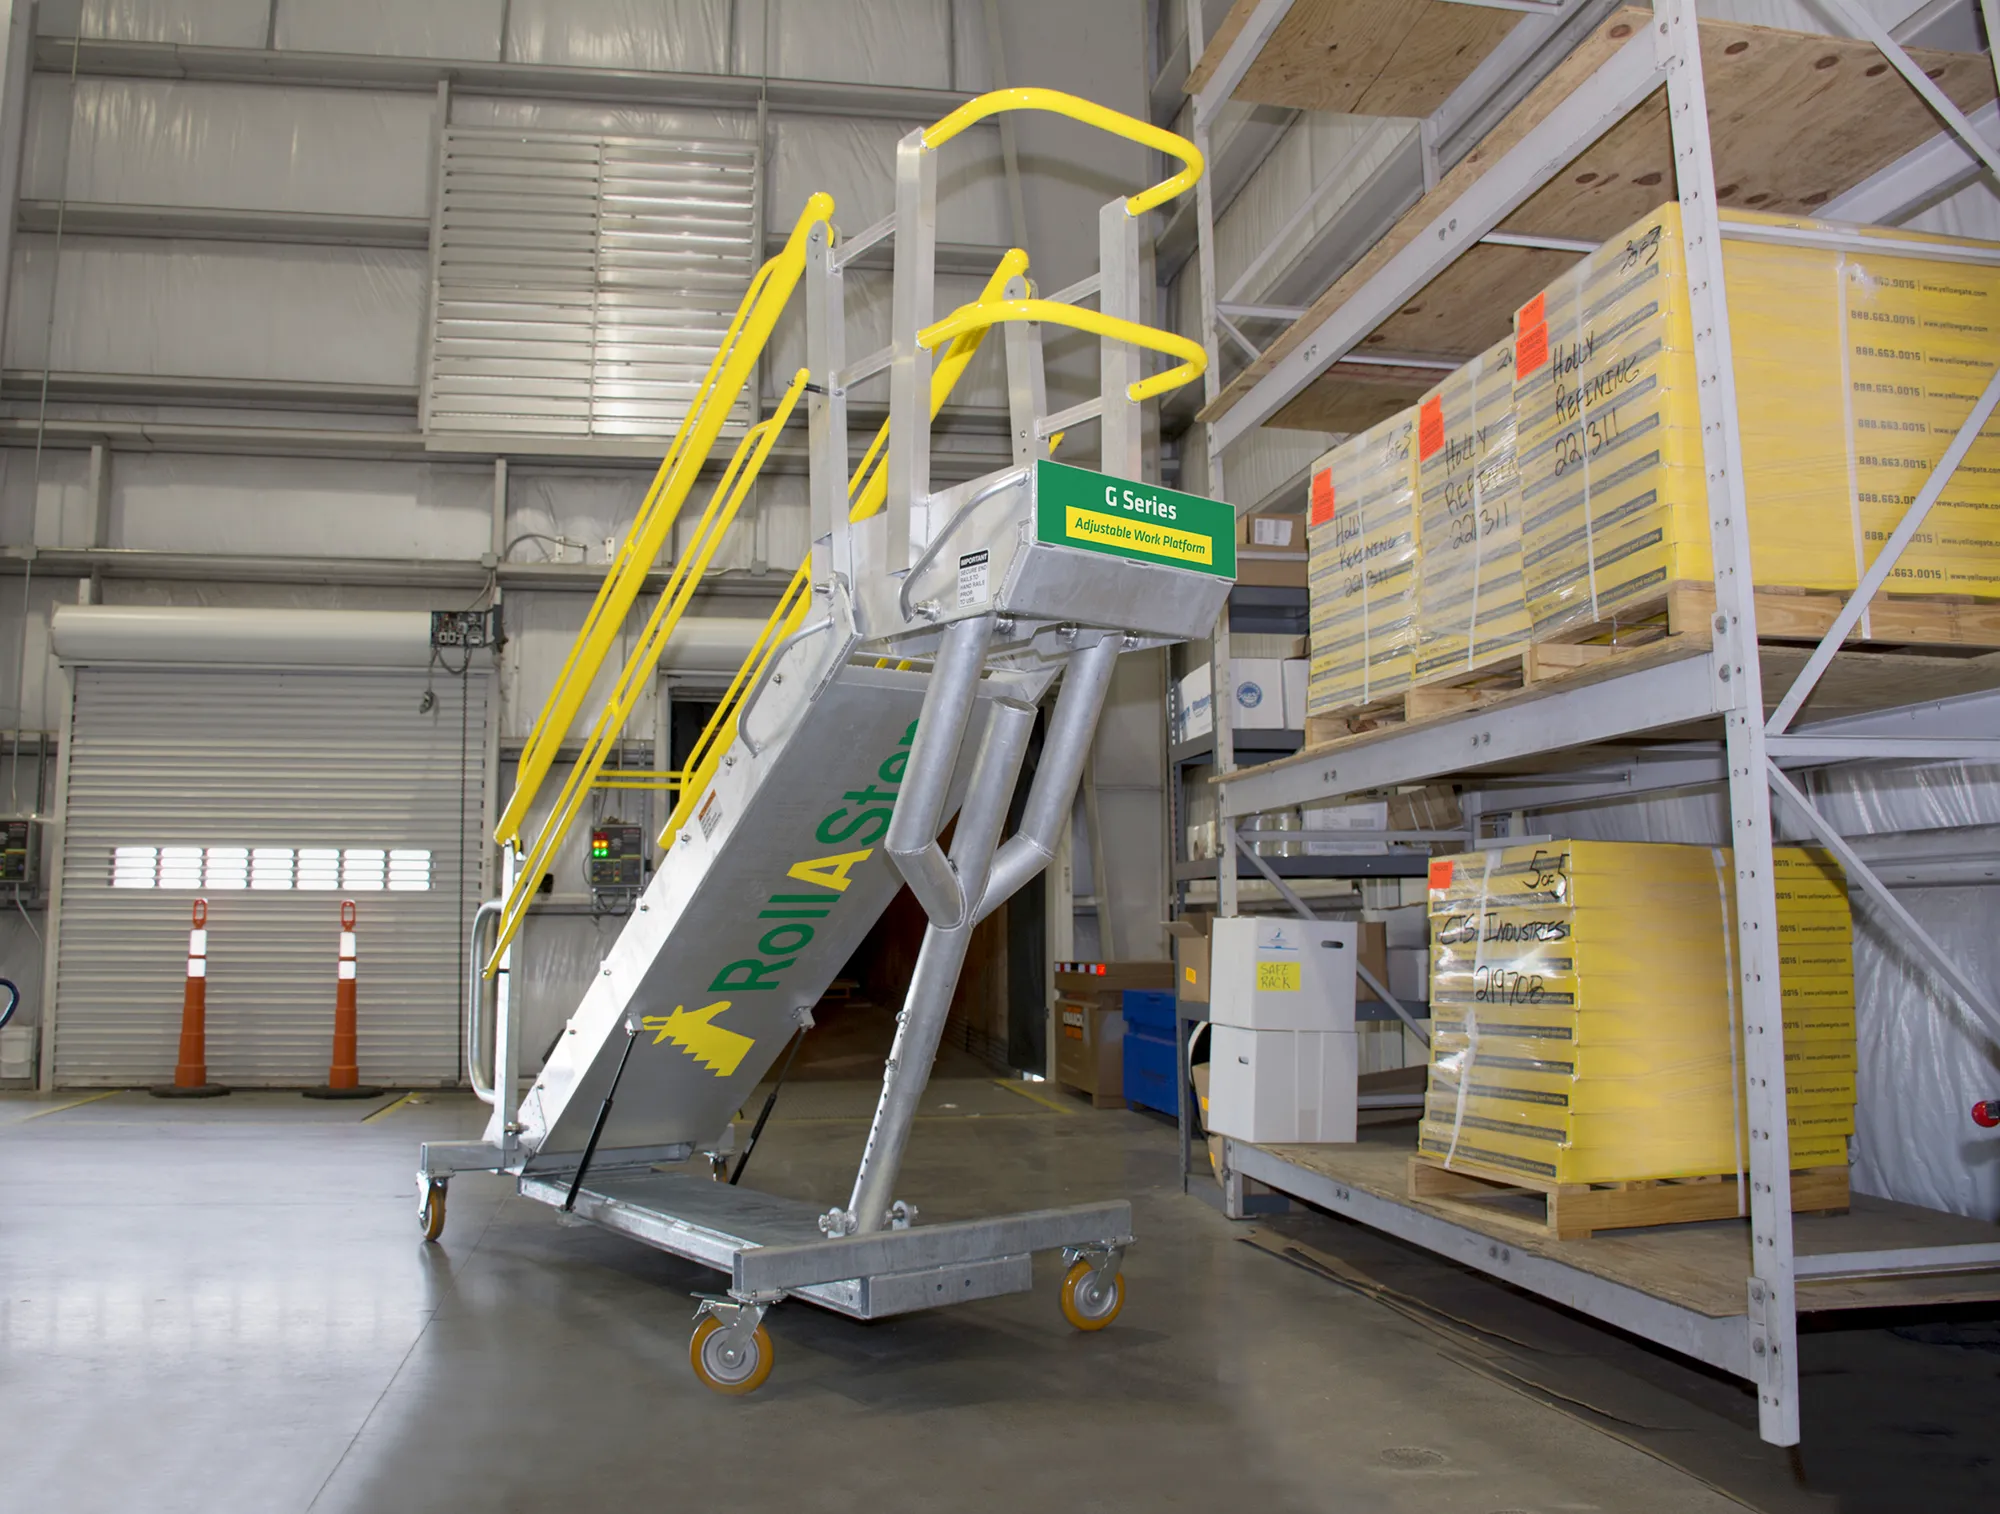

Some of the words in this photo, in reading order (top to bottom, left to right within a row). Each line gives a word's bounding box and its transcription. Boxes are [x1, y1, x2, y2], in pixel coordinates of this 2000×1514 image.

[1850, 310, 1916, 326] 888.663.0015
[1855, 346, 1921, 361] 888.663.0015
[1853, 382, 1921, 397] 888.663.0015
[1857, 418, 1926, 433] 888.663.0015
[1554, 407, 1619, 477] 221311
[1859, 455, 1927, 469] 888.663.0015
[1104, 485, 1117, 507] G
[1122, 489, 1177, 521] Series
[1074, 517, 1132, 540] Adjustable
[1133, 528, 1161, 546] Work
[1162, 535, 1207, 555] Platform
[960, 553, 988, 566] IMPORTANT
[960, 567, 978, 576] SECURE
[1886, 567, 1942, 580] .663.0015
[1522, 850, 1548, 889] 5
[1549, 852, 1570, 899] 5
[1483, 912, 1567, 943] INDUSTRIES
[1260, 963, 1289, 976] SAFE
[1260, 975, 1291, 989] RACK
